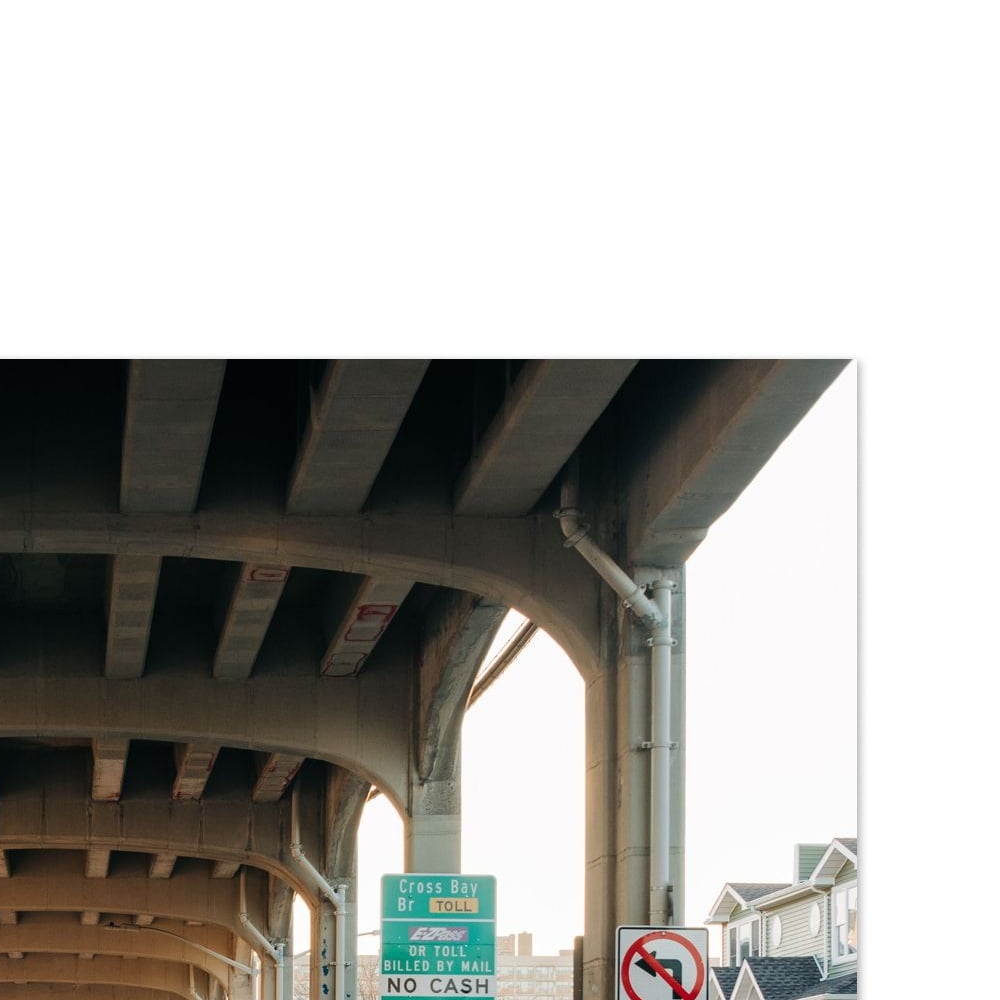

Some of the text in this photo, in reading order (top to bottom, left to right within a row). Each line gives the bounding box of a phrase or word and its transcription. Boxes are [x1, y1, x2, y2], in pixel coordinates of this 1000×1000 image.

[400, 879, 478, 895] Cross Bay
[398, 897, 472, 912] Br TOLL
[409, 945, 466, 957] OR TOLL
[384, 960, 492, 972] BILLED BY MAIL
[388, 977, 489, 994] NO CASH
